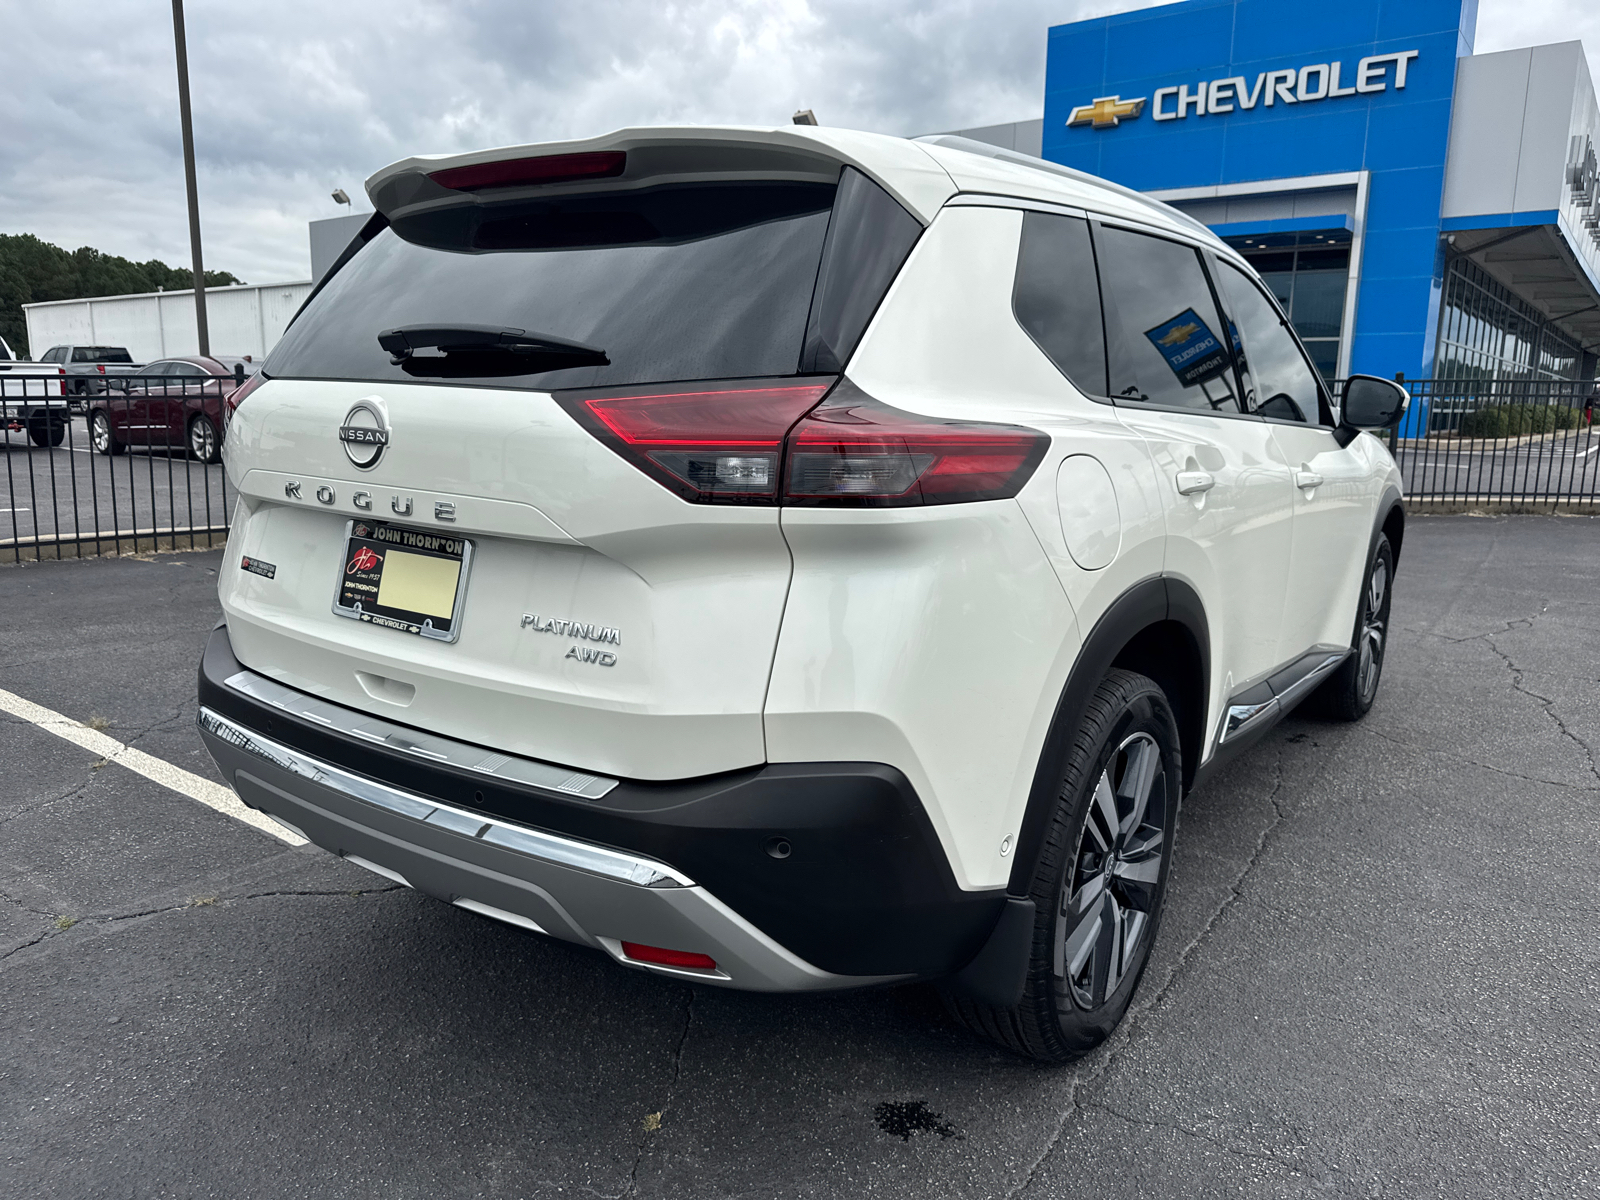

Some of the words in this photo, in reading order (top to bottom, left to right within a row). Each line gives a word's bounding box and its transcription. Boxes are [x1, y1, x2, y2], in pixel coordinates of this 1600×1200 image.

[1152, 49, 1419, 121] CHEVROLET
[340, 429, 386, 443] NISSAN
[285, 480, 457, 522] ROGUE
[373, 527, 401, 542] JOHN
[372, 617, 408, 630] CHEVROLET
[520, 613, 620, 645] PLATINUM
[565, 645, 617, 667] AWD
